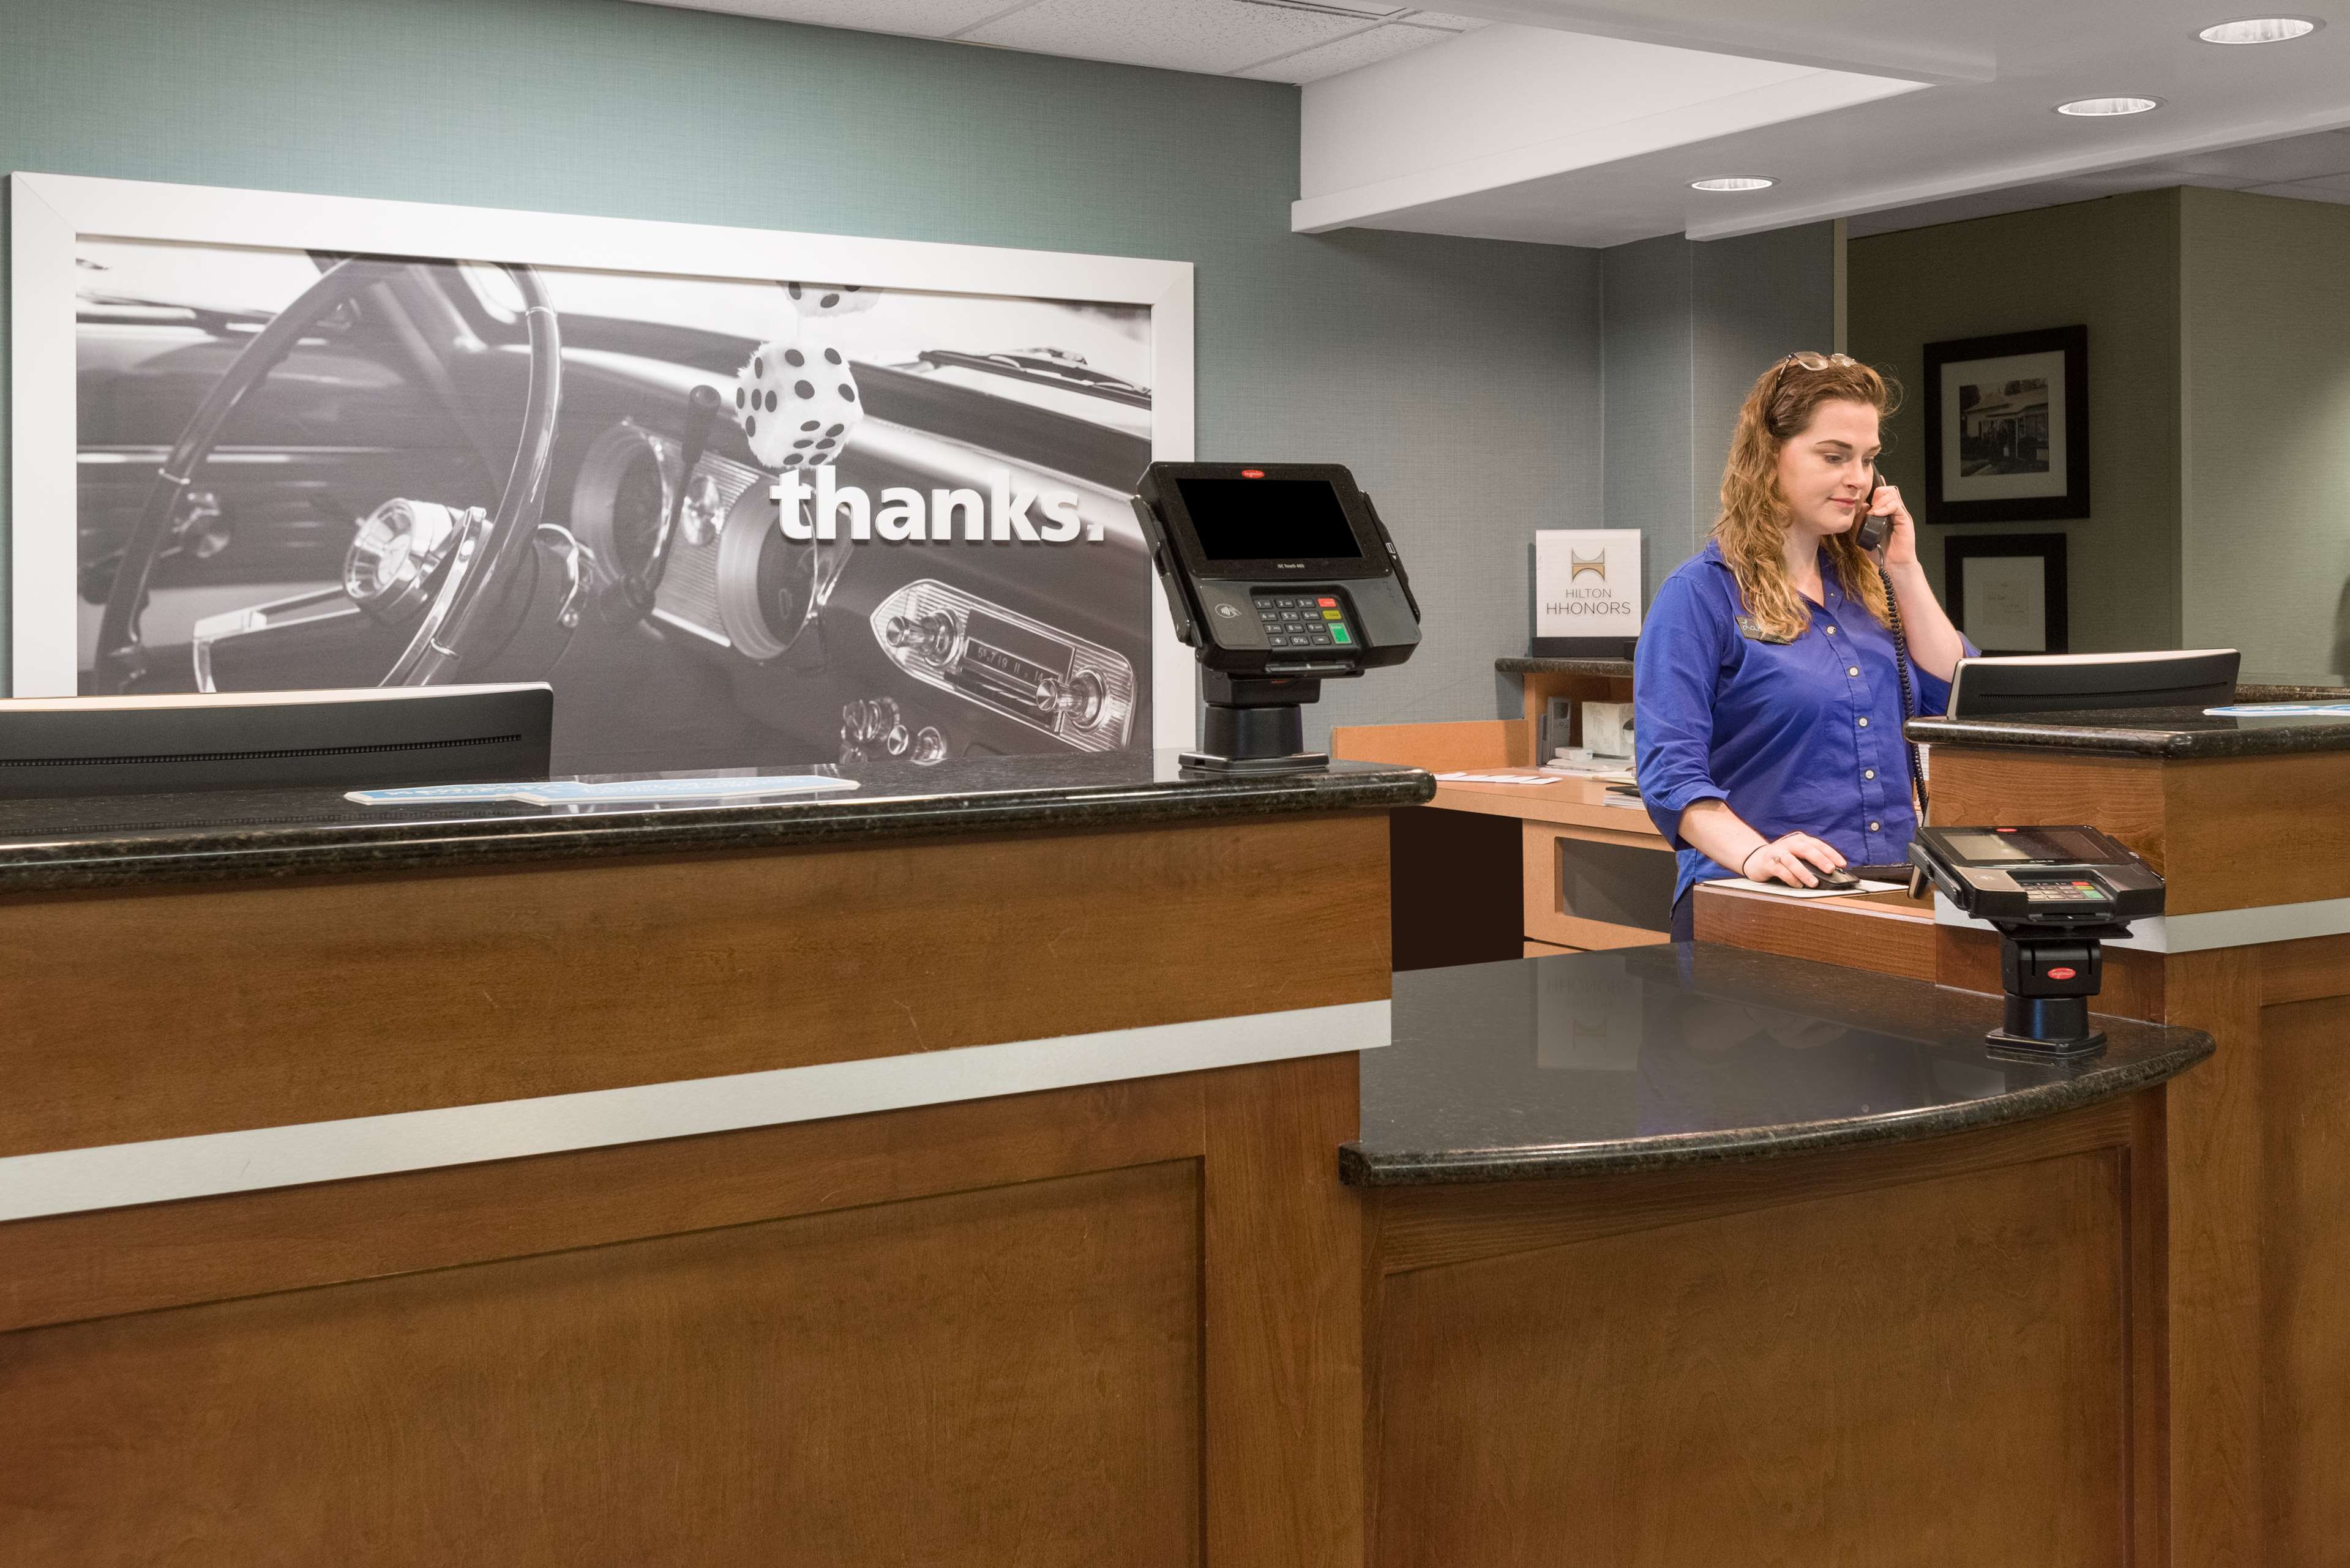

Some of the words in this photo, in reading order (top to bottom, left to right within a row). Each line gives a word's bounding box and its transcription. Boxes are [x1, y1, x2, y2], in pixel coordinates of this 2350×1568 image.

[769, 465, 1105, 542] thanks.
[1566, 588, 1611, 598] HILTON
[1547, 602, 1631, 614] HHONORS
